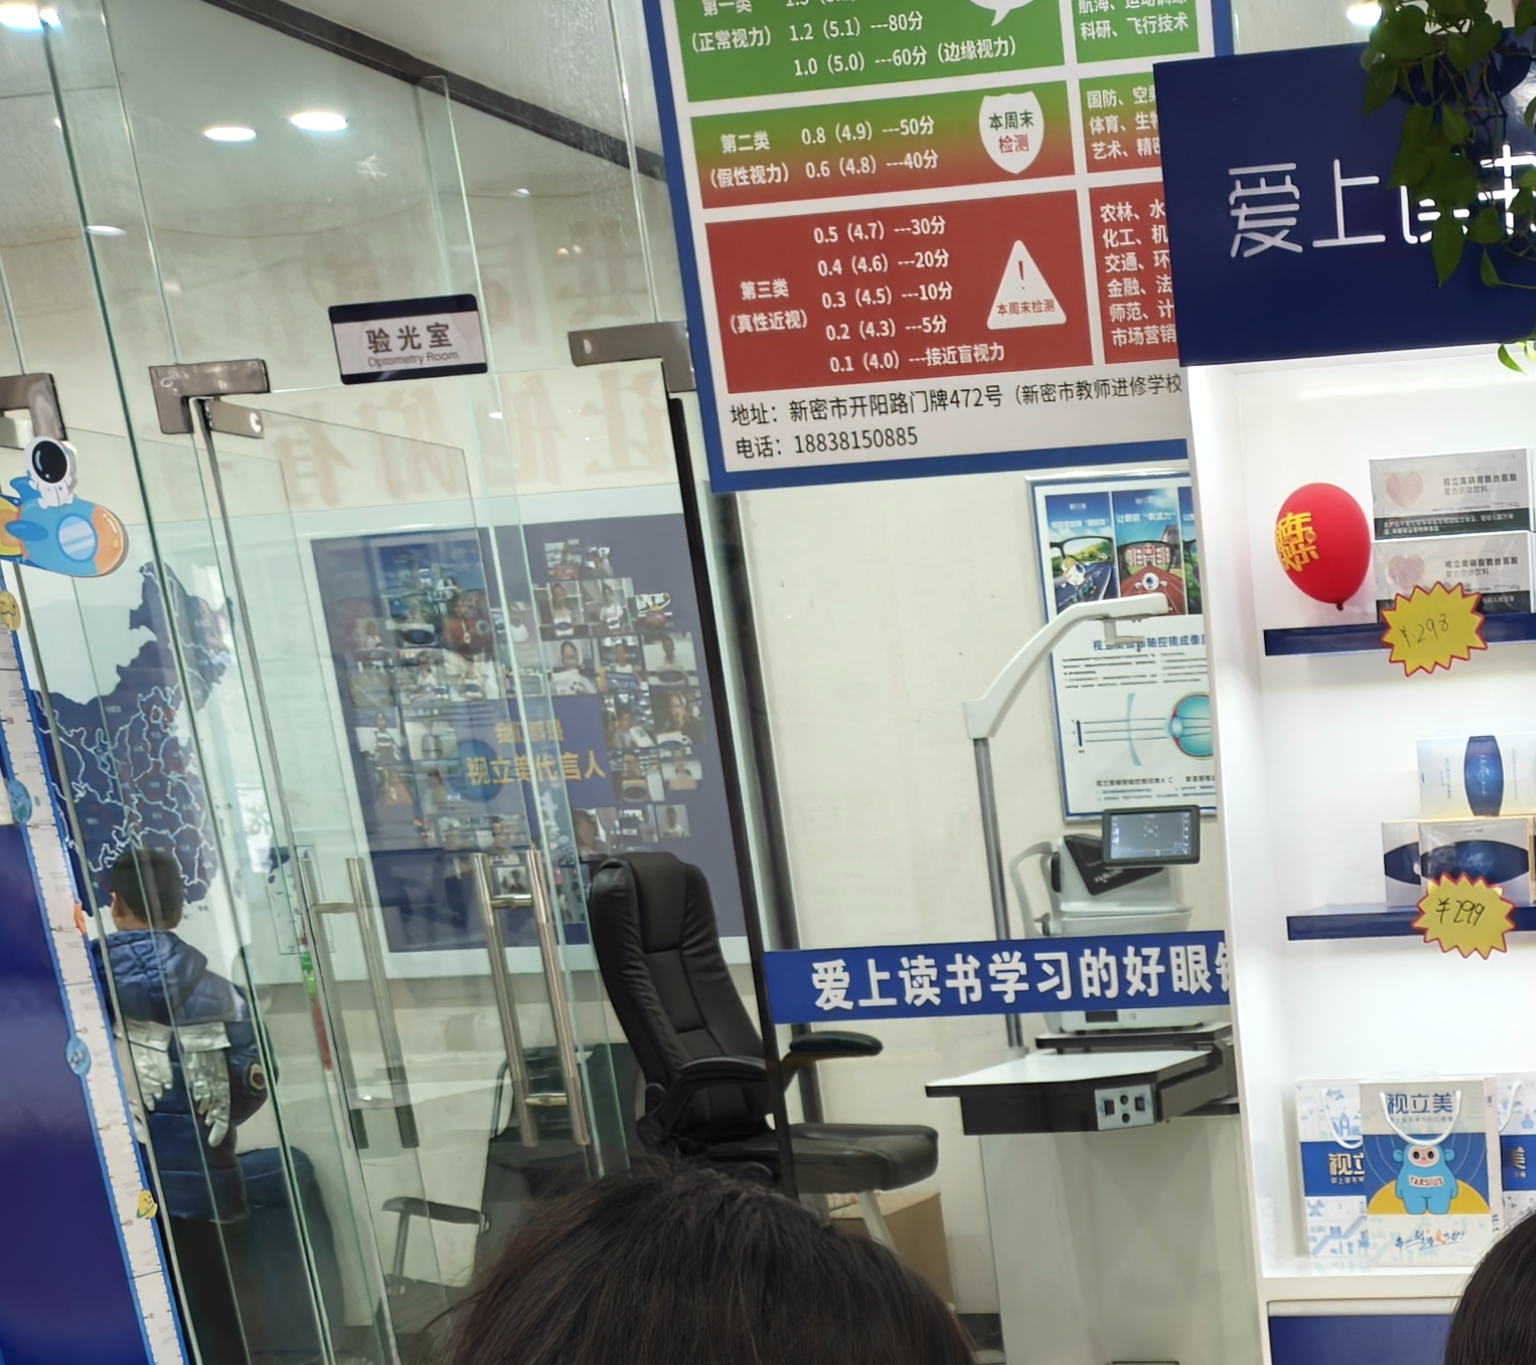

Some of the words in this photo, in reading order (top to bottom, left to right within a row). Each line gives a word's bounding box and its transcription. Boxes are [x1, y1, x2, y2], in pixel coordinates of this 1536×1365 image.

[691, 26, 771, 52] (正常视力)
[1080, 13, 1189, 40] 科研、飞行技术
[938, 35, 1016, 64] (边缘视力)
[988, 110, 1034, 131] 本周末
[720, 130, 770, 154] 第二类
[710, 162, 789, 189] (假性视力)
[740, 278, 789, 301] 第三类
[997, 299, 1055, 317] 本周末检测
[729, 309, 807, 334] (真性近视)
[365, 322, 452, 354] 验光室
[368, 354, 425, 369] Optometry
[427, 351, 459, 362] Room
[789, 385, 1003, 423] 新密市开阳路门牌472号
[794, 426, 918, 455] 18838150885
[1387, 1093, 1453, 1115] 视立美
